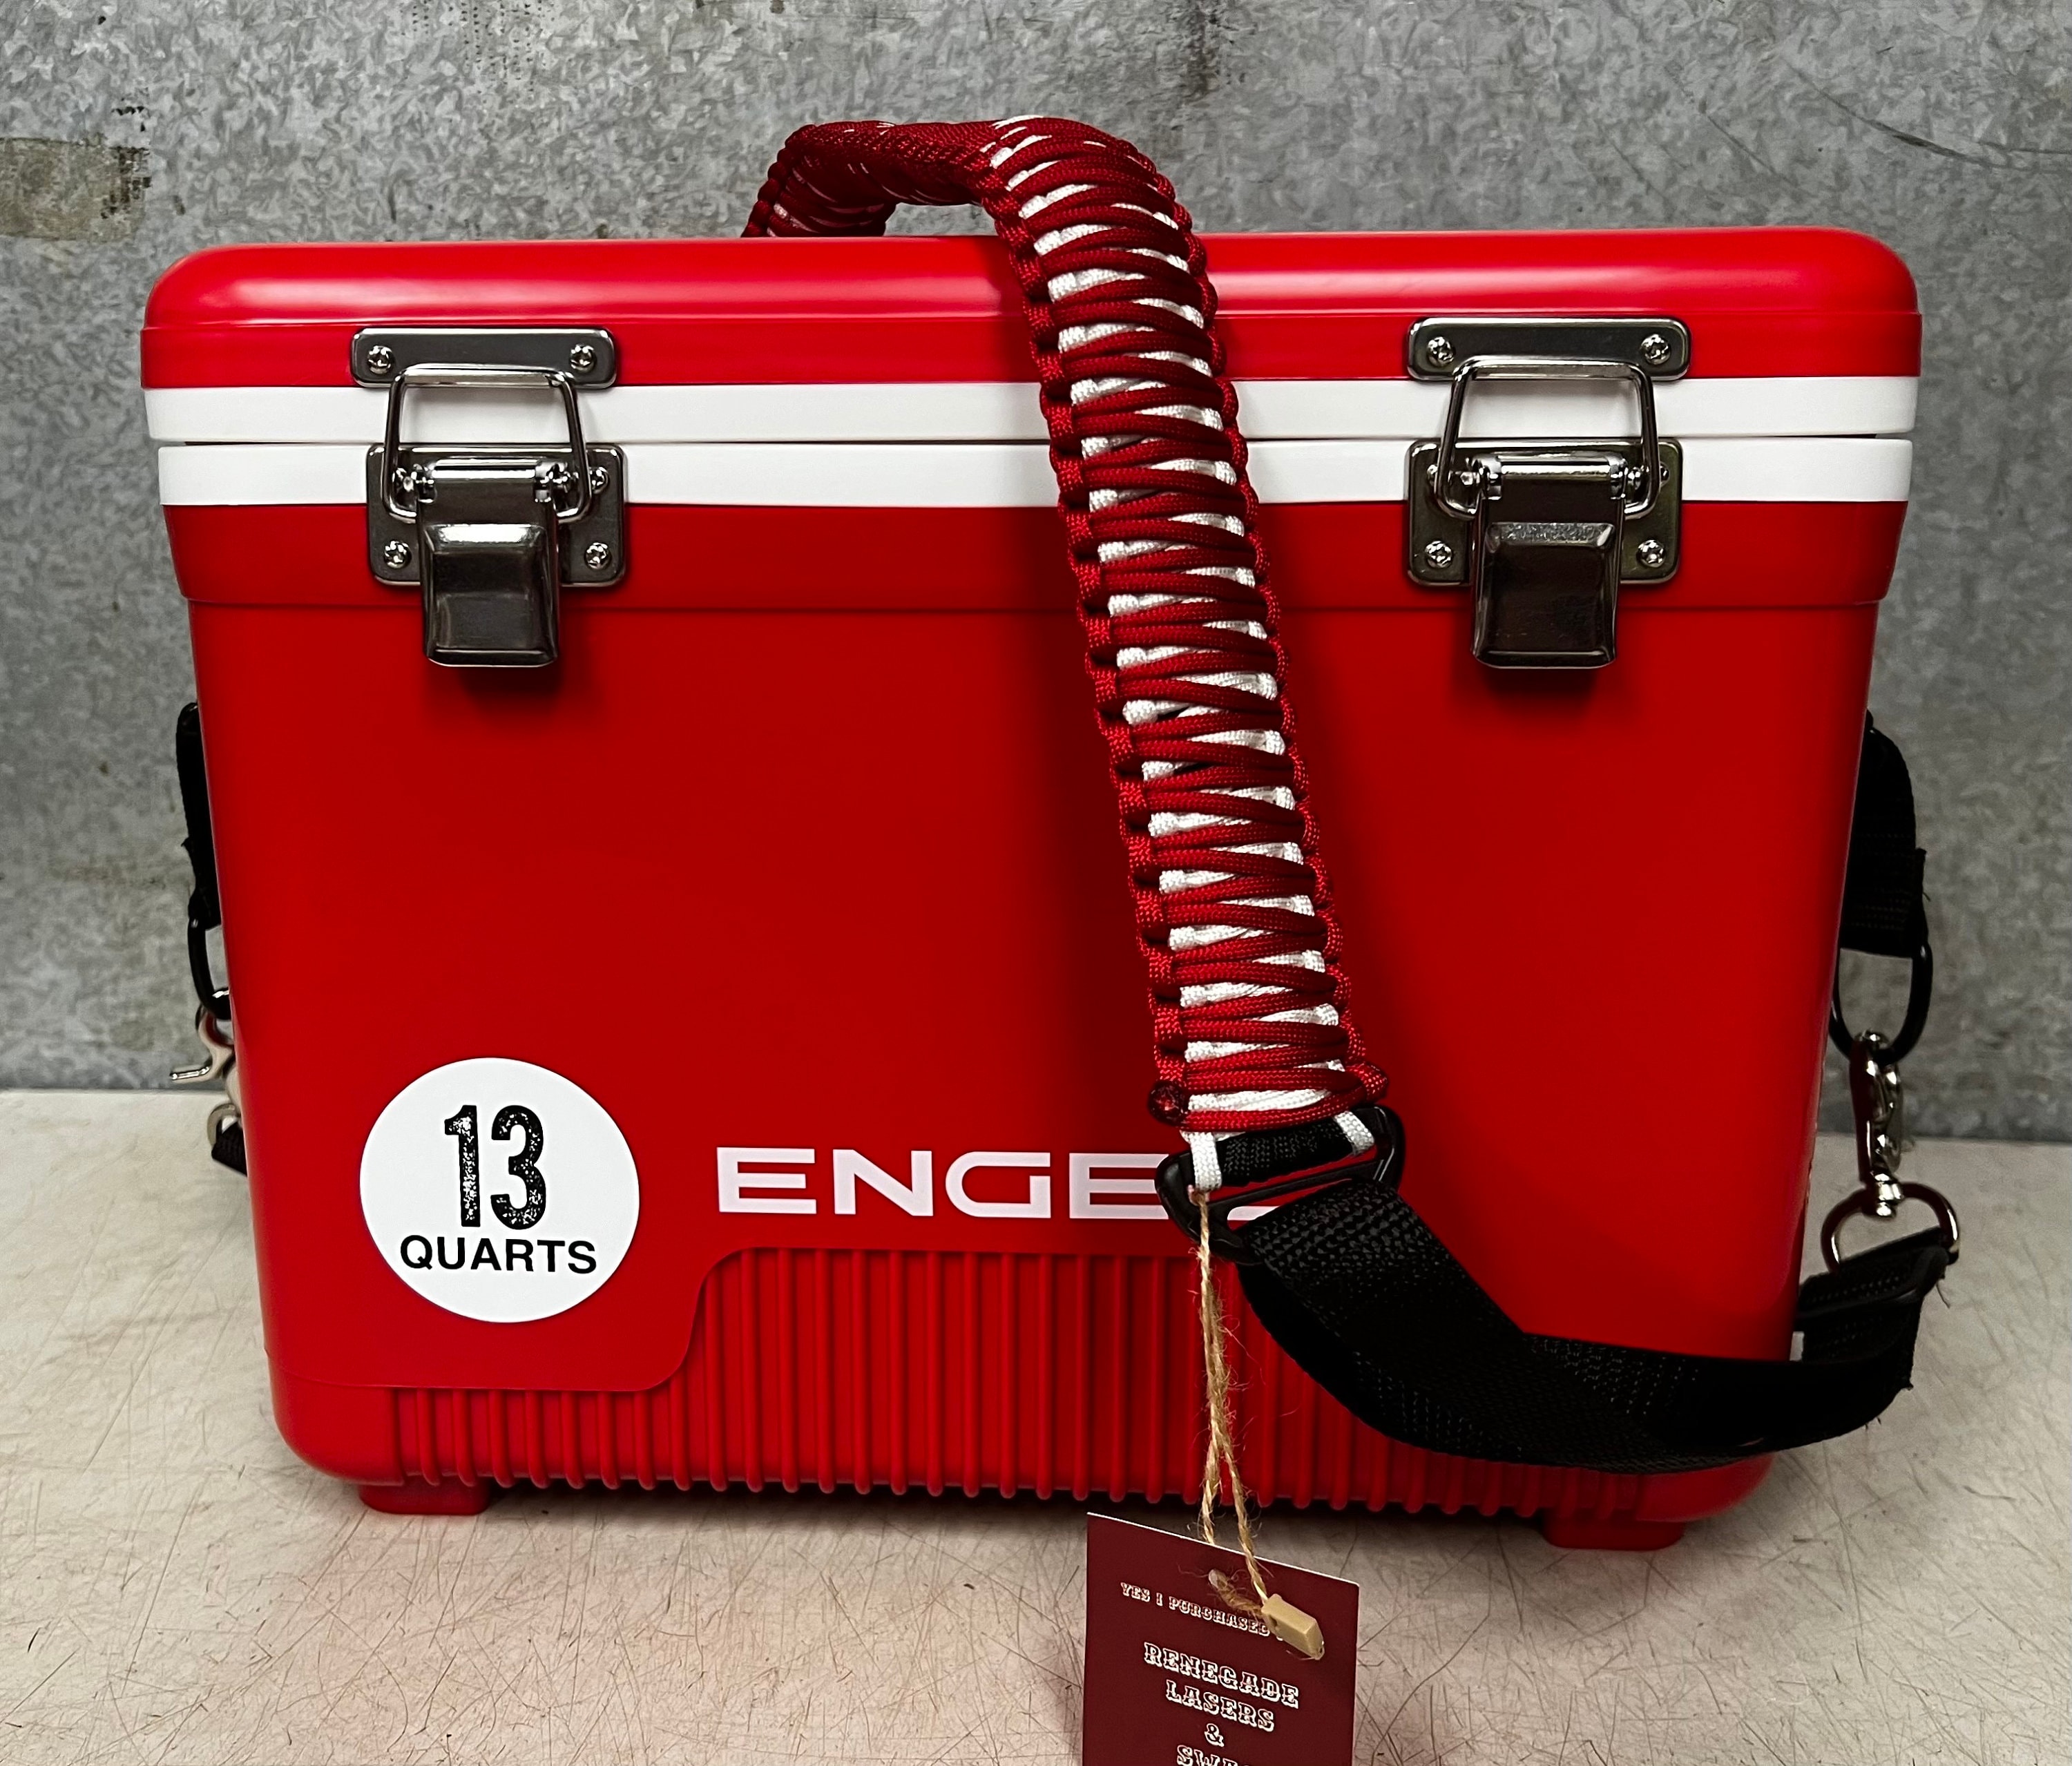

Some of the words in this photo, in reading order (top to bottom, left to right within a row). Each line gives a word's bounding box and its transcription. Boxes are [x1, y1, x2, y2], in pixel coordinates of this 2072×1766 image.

[445, 1105, 546, 1229] 13
[716, 1147, 1281, 1221] ENGE
[400, 1235, 597, 1274] QUARTS
[1120, 1582, 1151, 1602] YES
[1169, 1596, 1270, 1637] PURCHASED
[1144, 1642, 1299, 1709] RENEGADE
[1166, 1679, 1275, 1732] LASERS
[1204, 1722, 1225, 1747] &
